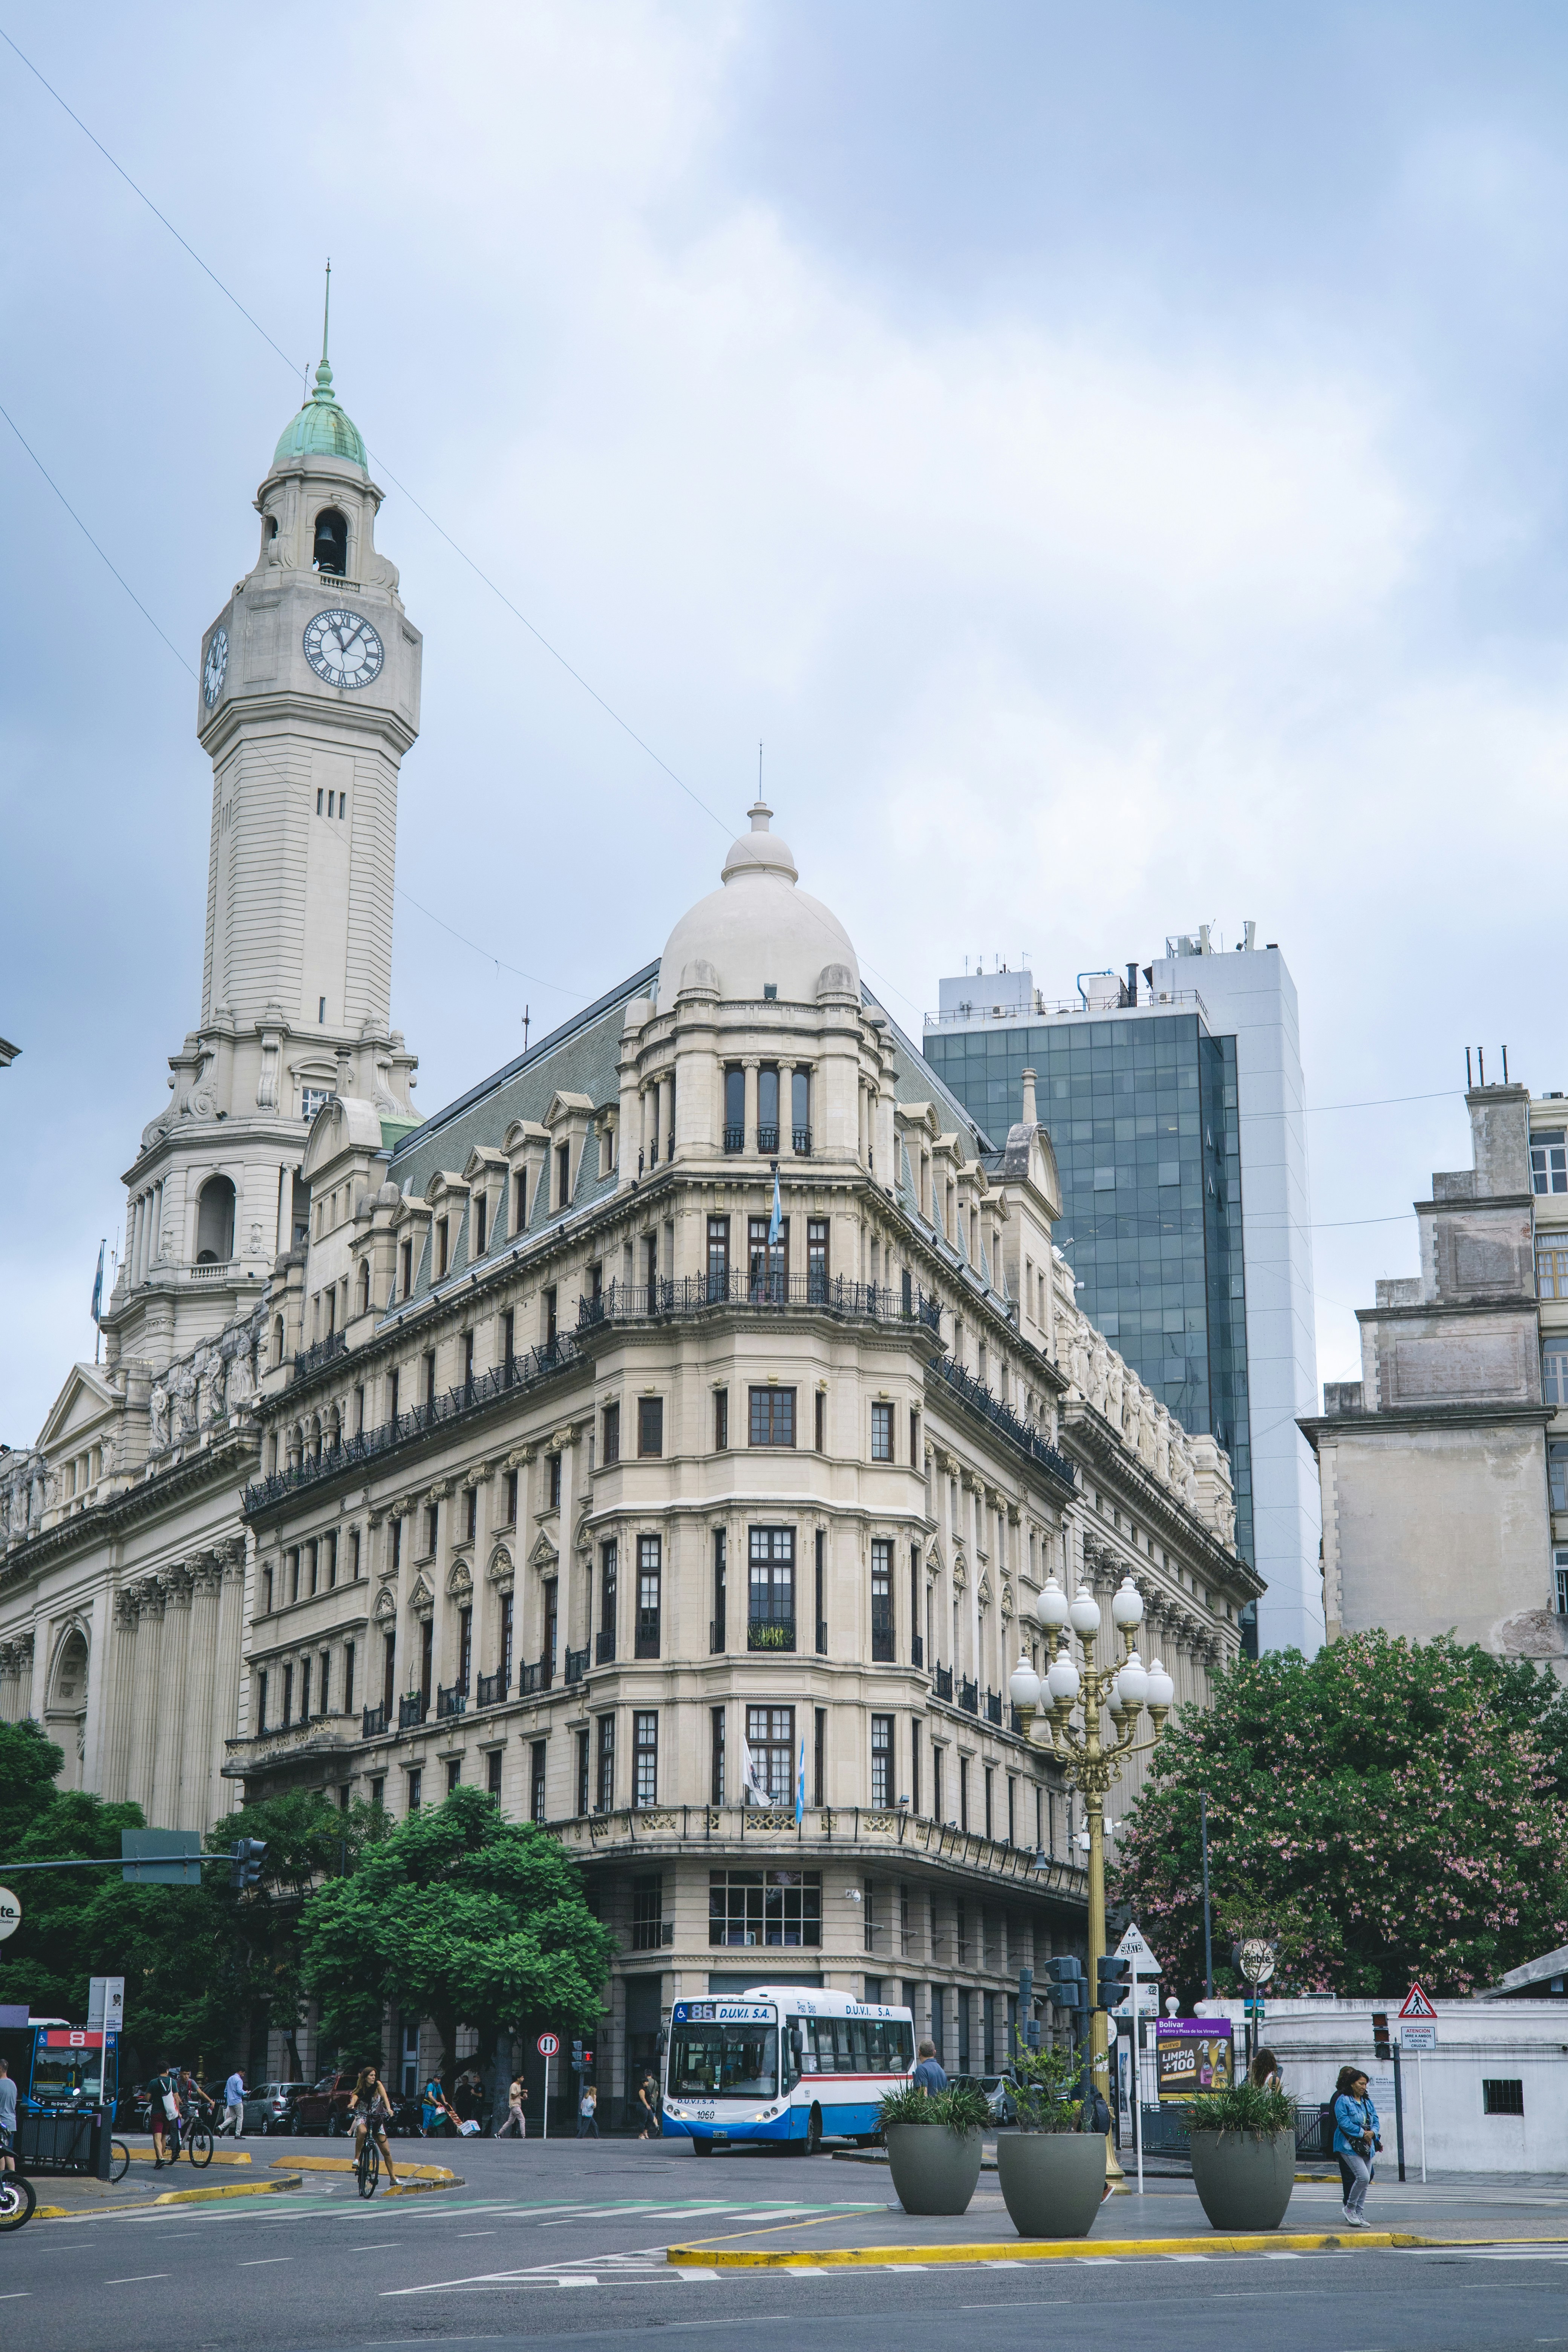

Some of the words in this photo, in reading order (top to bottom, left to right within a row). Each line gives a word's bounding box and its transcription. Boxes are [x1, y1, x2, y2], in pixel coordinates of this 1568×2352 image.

[0, 1906, 20, 1918] te
[1121, 1943, 1143, 1954] SKATE!
[692, 2004, 713, 2019] 86
[720, 2009, 749, 2018] D.U.V.I.
[752, 2009, 769, 2018] S.A.
[797, 2001, 805, 2013] Piso
[807, 2002, 816, 2015] Bajo
[846, 2006, 871, 2015] D.U.V.I.
[878, 2007, 893, 2017] S.A.
[70, 2032, 85, 2046] 8
[1162, 2049, 1194, 2062] LIMPIA
[1164, 2058, 1195, 2072] +100
[1163, 2072, 1194, 2080] SUPERFICIES
